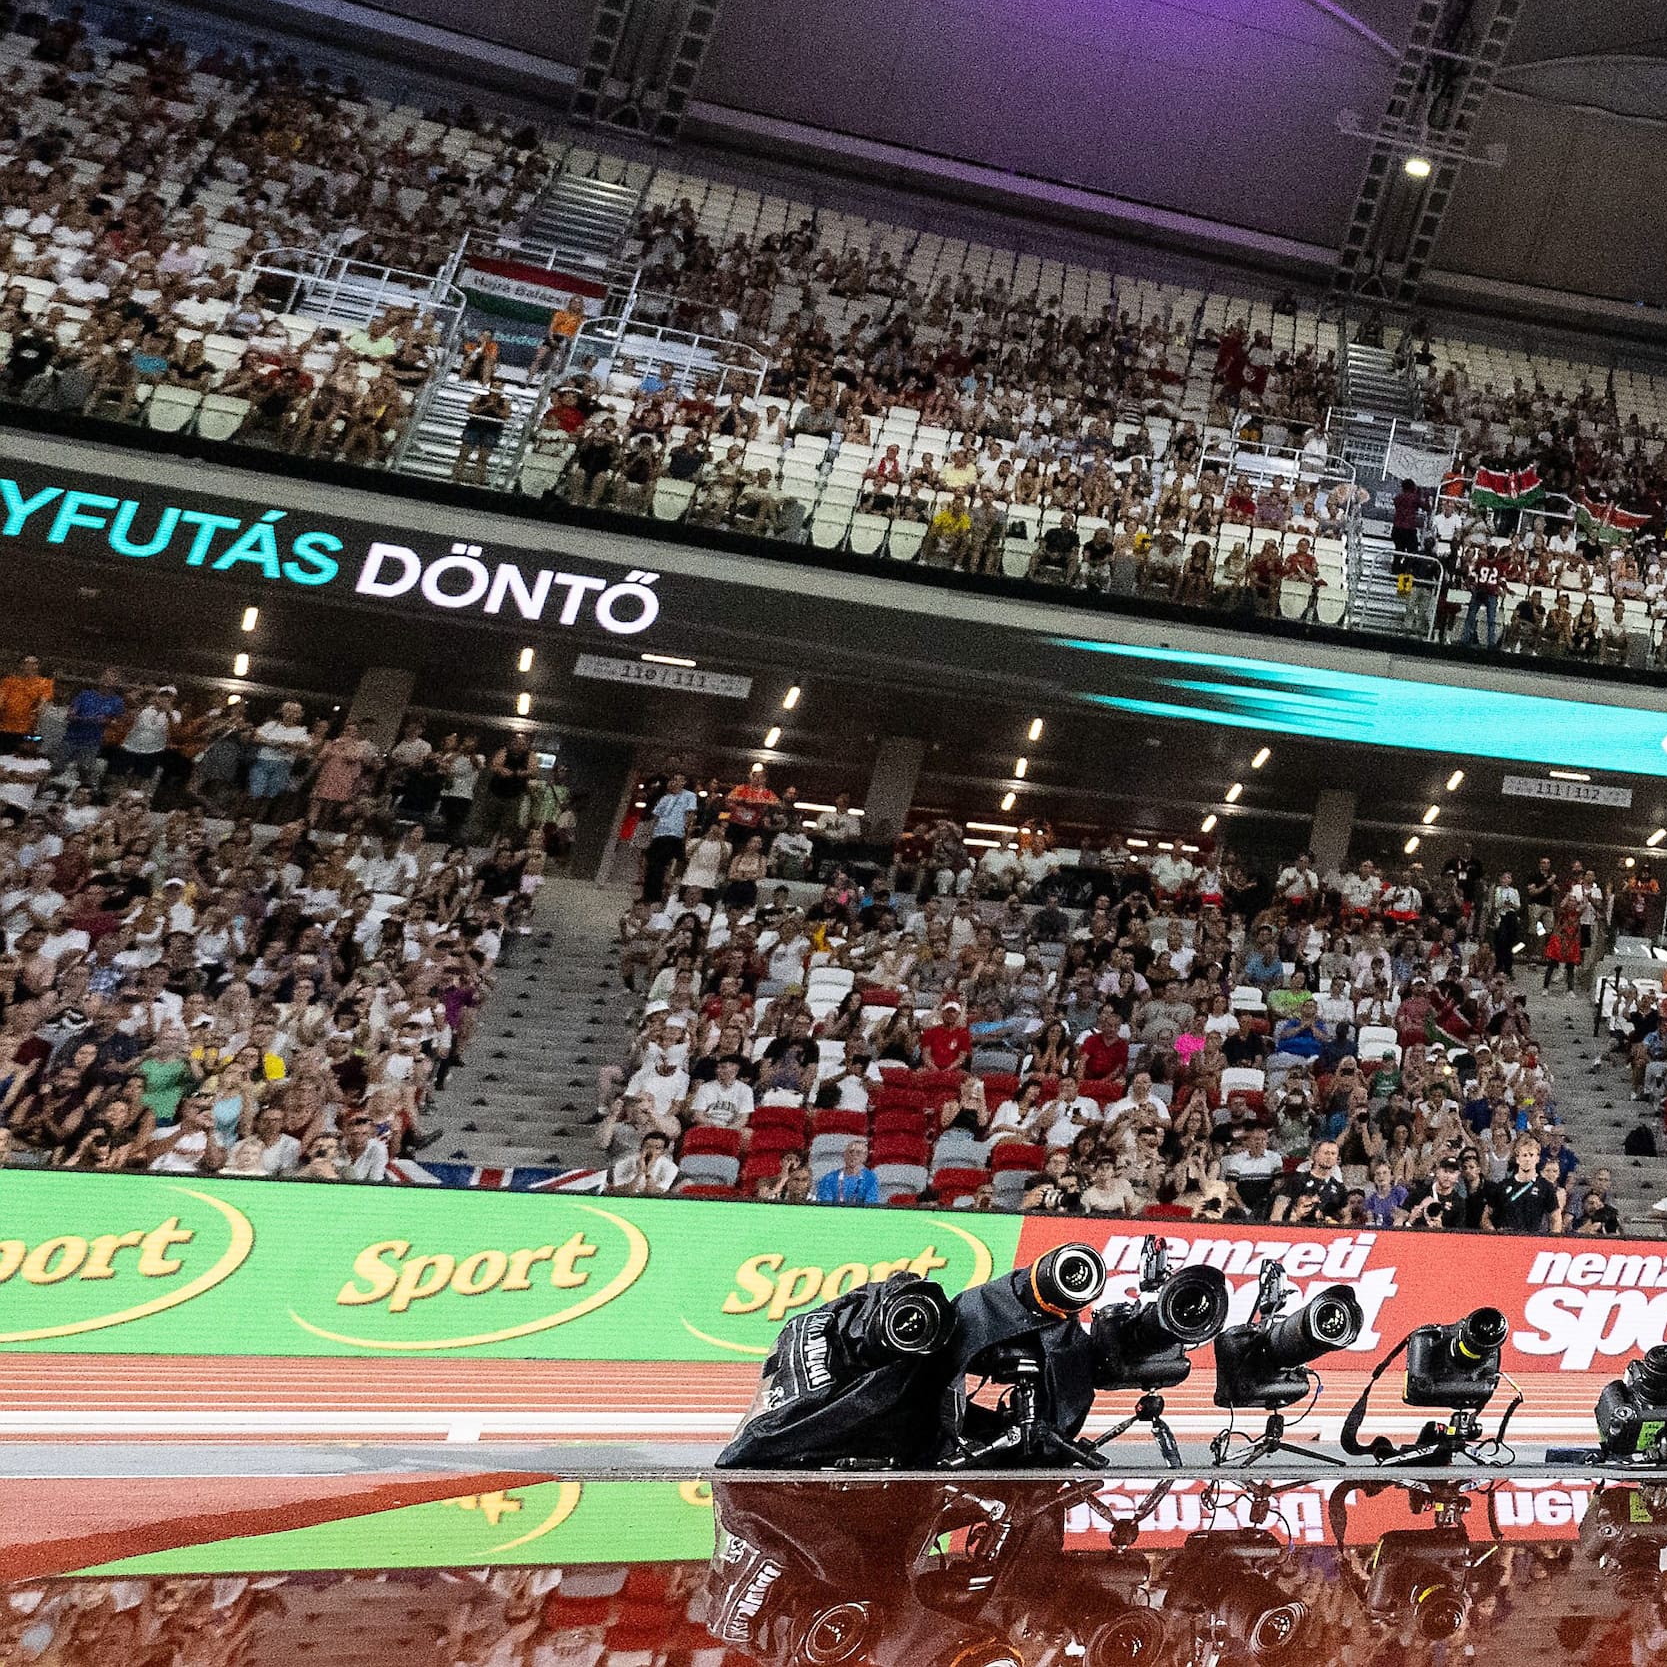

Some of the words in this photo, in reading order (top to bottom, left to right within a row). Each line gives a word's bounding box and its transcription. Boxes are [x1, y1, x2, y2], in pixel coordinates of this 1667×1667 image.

[0, 477, 344, 585] YFUTÁS
[355, 542, 661, 635] DÖNTŐ
[336, 1233, 600, 1313] Sport
